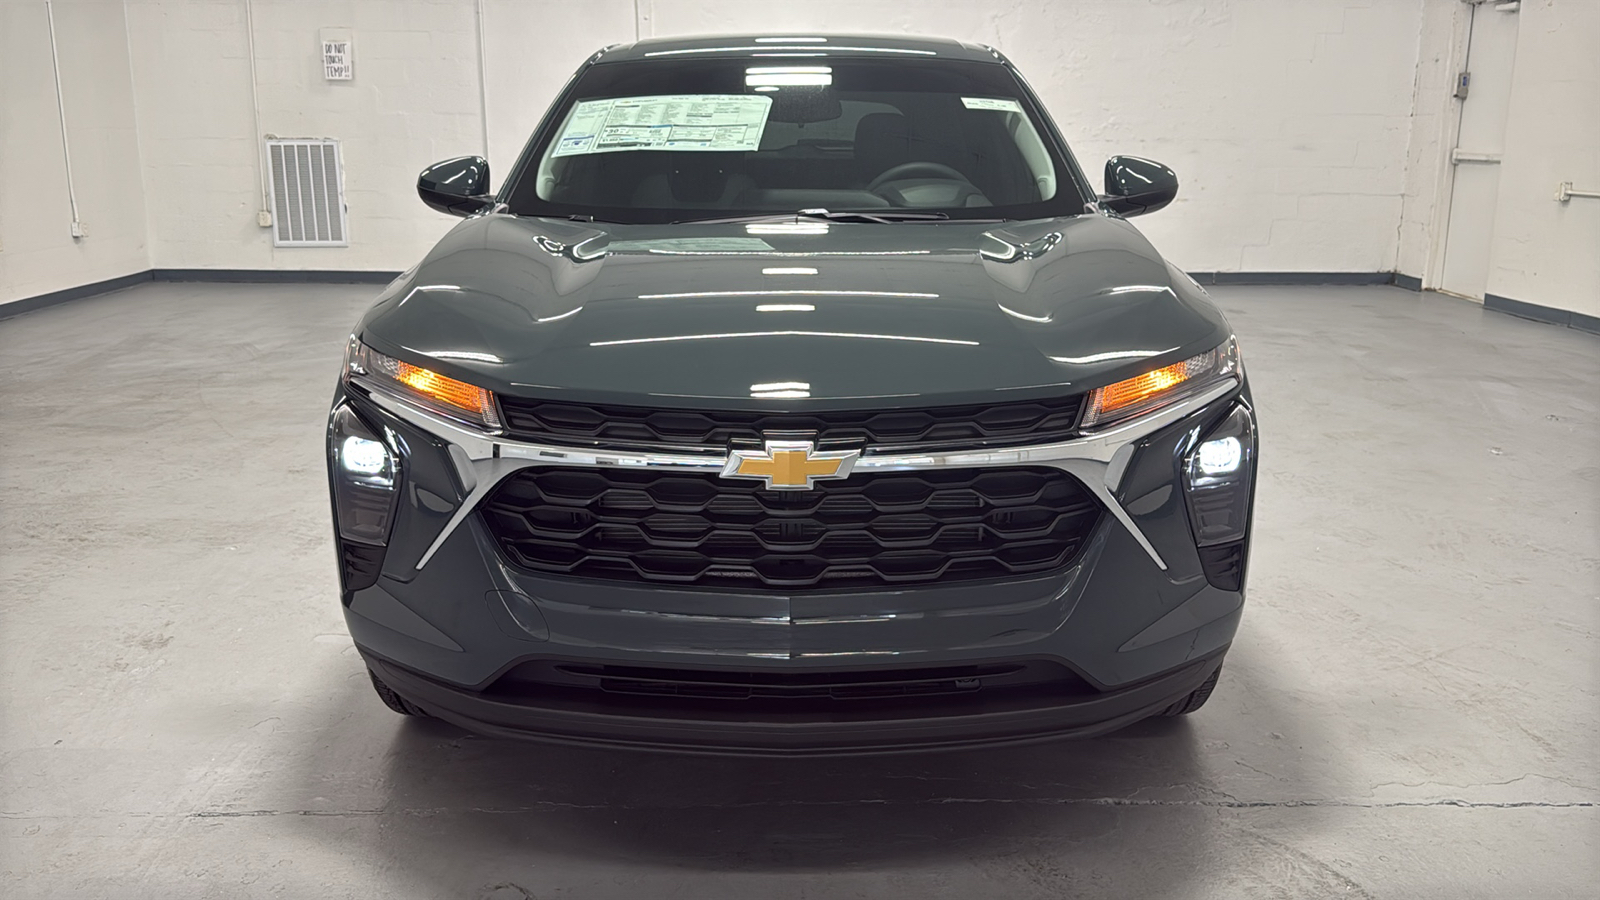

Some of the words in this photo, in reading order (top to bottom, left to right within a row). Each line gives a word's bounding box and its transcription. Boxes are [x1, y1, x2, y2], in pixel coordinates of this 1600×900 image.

[325, 44, 332, 54] DO
[334, 44, 347, 54] NOT
[325, 55, 343, 65] TOUCH
[326, 65, 349, 77] TEMP!!
